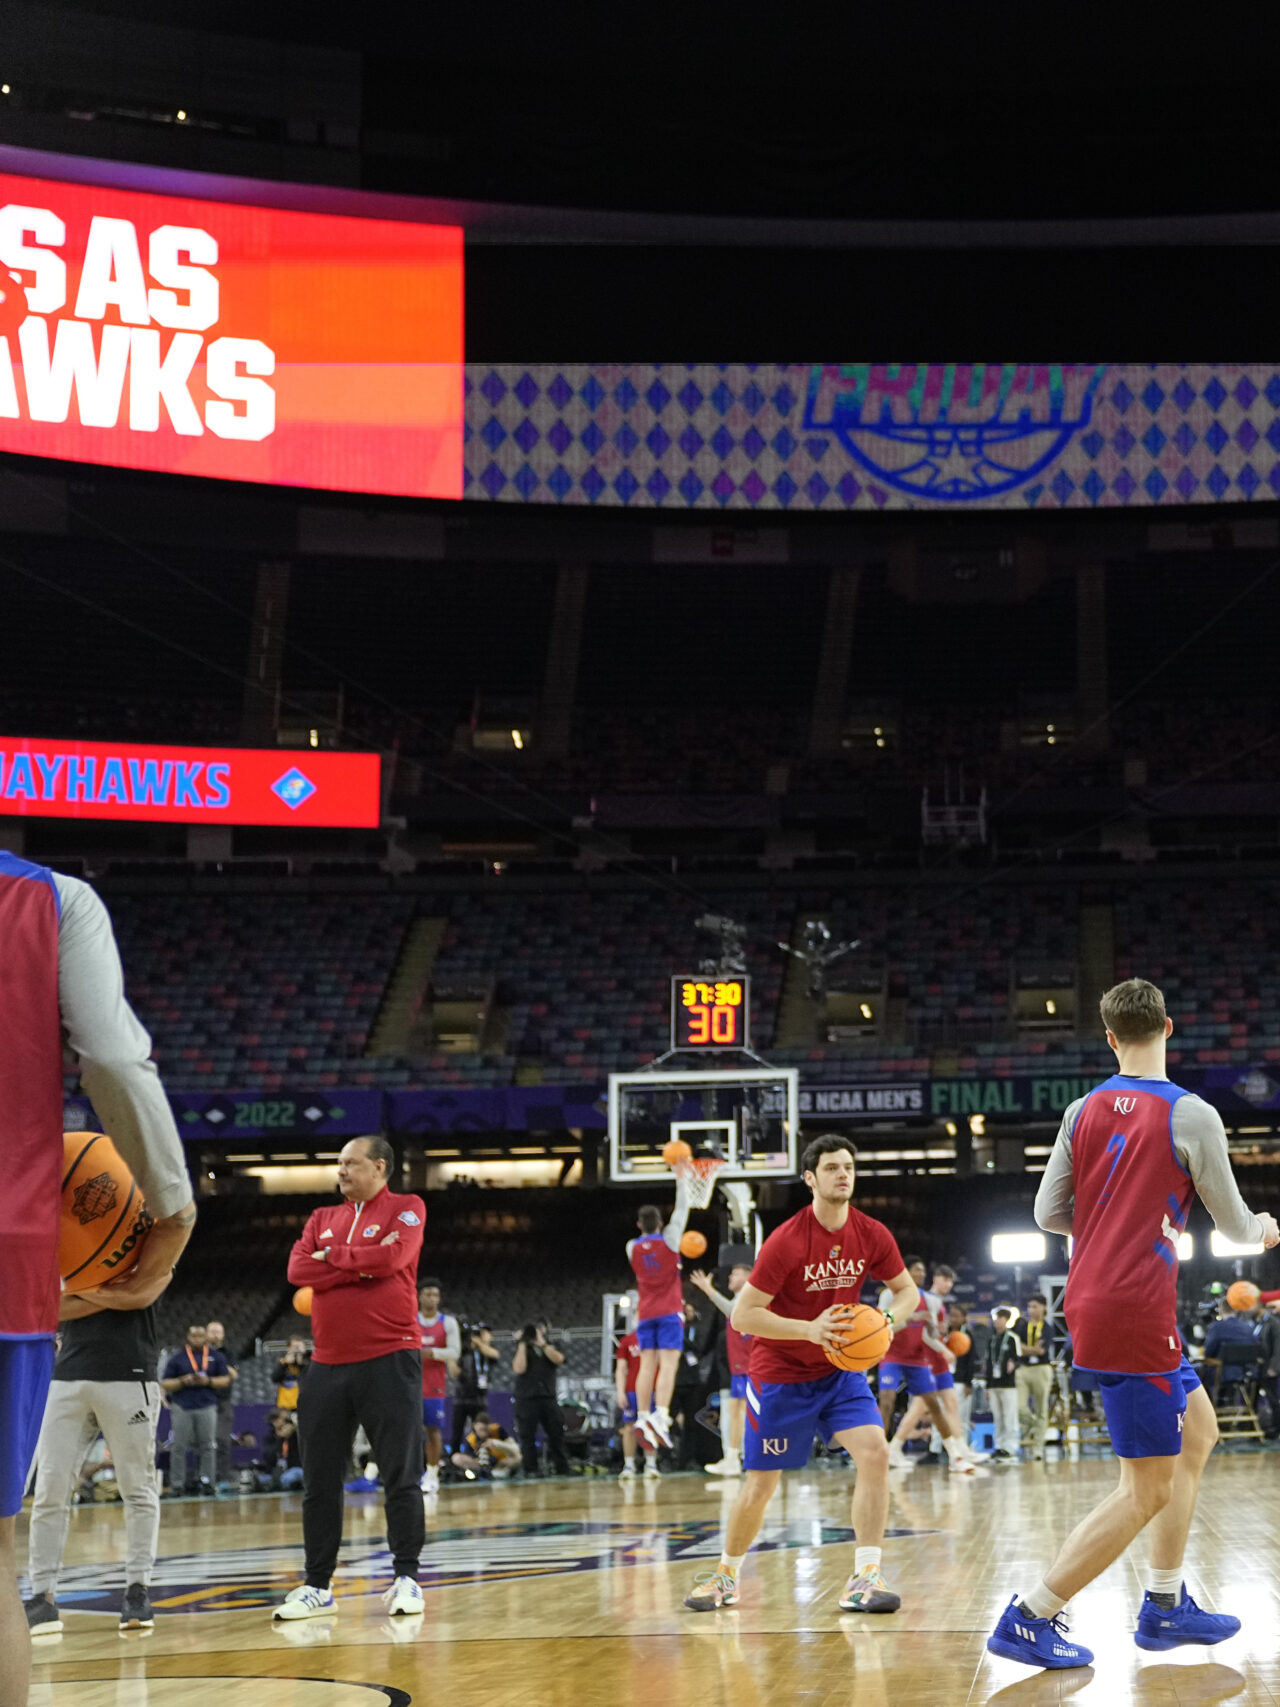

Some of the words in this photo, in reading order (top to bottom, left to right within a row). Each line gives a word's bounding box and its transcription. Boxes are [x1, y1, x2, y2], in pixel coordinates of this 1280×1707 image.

[0, 752, 231, 809] AYHAWKS
[682, 982, 742, 1007] 37:30
[688, 1004, 736, 1044] 30
[761, 1091, 813, 1113] 202
[815, 1091, 863, 1112] NCAA
[867, 1088, 923, 1111] MEN'S
[931, 1080, 1022, 1114] FINAL
[1031, 1077, 1109, 1111] FOU
[1113, 1096, 1137, 1115] KU
[234, 1102, 296, 1128] 2022
[803, 1258, 865, 1281] KANSAS
[762, 1438, 788, 1455] KU
